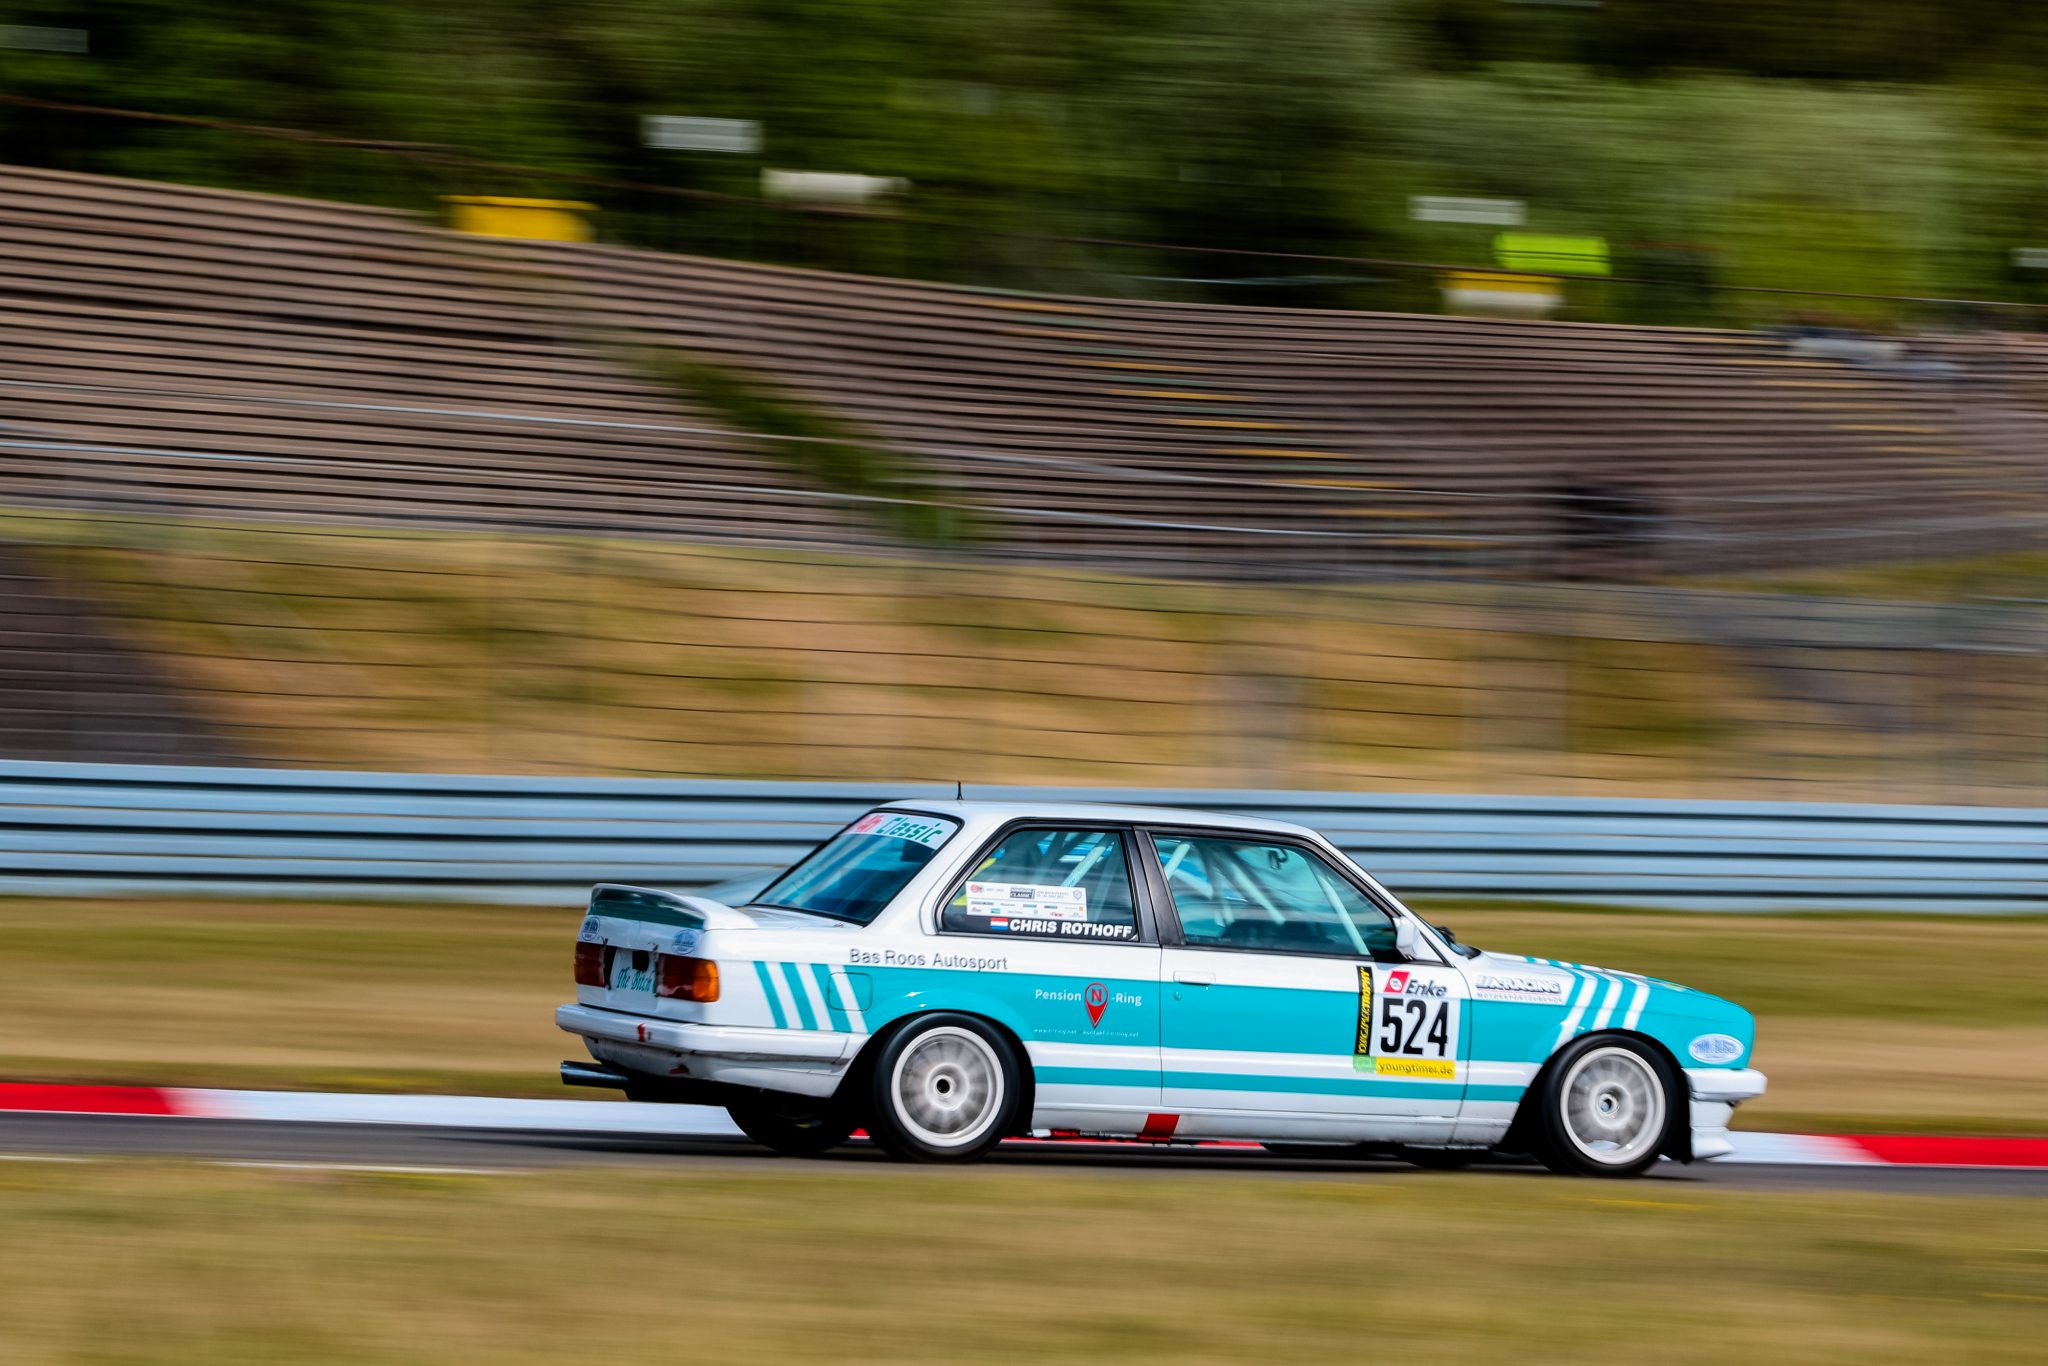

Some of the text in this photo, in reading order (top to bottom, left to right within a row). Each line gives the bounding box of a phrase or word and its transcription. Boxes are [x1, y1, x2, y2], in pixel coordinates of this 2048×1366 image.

[876, 817, 943, 843] Classic
[1009, 918, 1133, 938] CHRIS ROTHOFF
[849, 948, 1008, 973] Bas Roos Autosport
[1035, 988, 1081, 1001] Pension
[1091, 987, 1103, 1003] N
[1380, 997, 1449, 1057] 524
[1379, 1062, 1454, 1076] youngtimer.de
